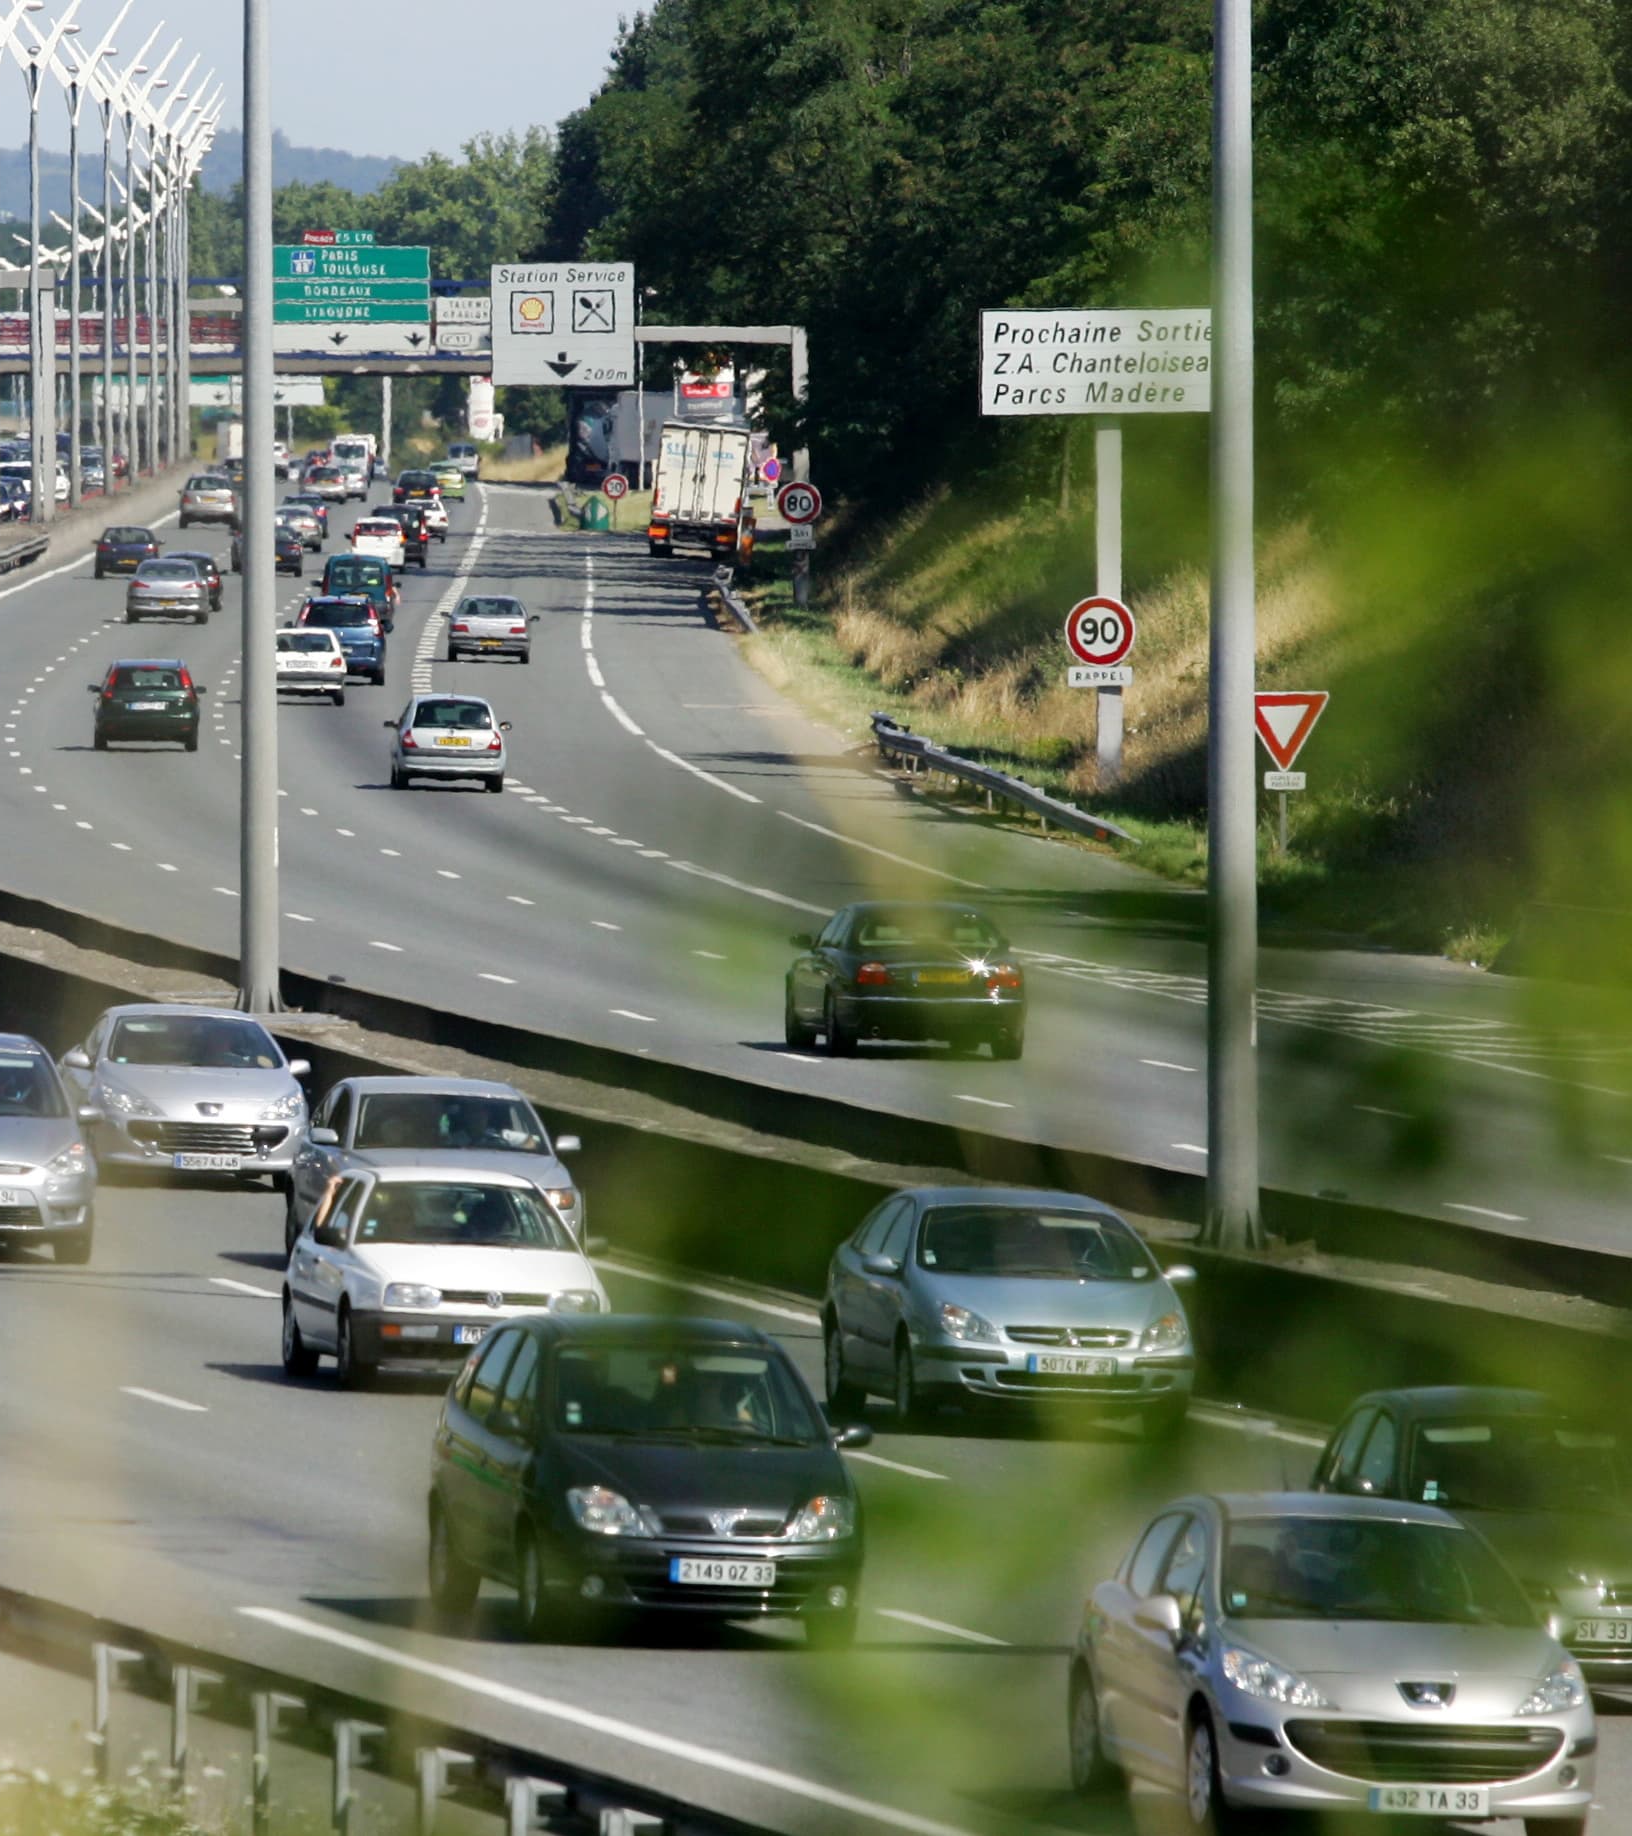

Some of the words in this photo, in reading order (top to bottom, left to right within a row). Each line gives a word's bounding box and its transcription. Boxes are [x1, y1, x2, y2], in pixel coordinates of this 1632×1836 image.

[321, 250, 359, 261] PARIS
[322, 264, 387, 275] TOULOUSE
[498, 268, 558, 284] Station
[566, 268, 625, 283] Service
[304, 286, 372, 297] BORDEAUX
[449, 300, 489, 309] TALENC
[993, 320, 1122, 345] Prochaine
[1136, 319, 1213, 343] Sortie
[993, 352, 1041, 375] Z.A.
[1052, 351, 1210, 375] Chanteloisea
[583, 368, 628, 381] 200m
[993, 383, 1067, 406] Parcs
[1085, 381, 1186, 404] Madère
[787, 495, 812, 512] 80
[1080, 616, 1119, 646] 90
[1075, 671, 1125, 682] RAPPEL
[683, 1562, 723, 1580] 2149
[728, 1564, 748, 1581] QZ
[753, 1565, 773, 1582] 33
[1578, 1621, 1599, 1639] SV
[1607, 1621, 1628, 1640] 33
[1385, 1790, 1420, 1809] 432
[1427, 1790, 1449, 1809] TA
[1455, 1791, 1480, 1811] 33
